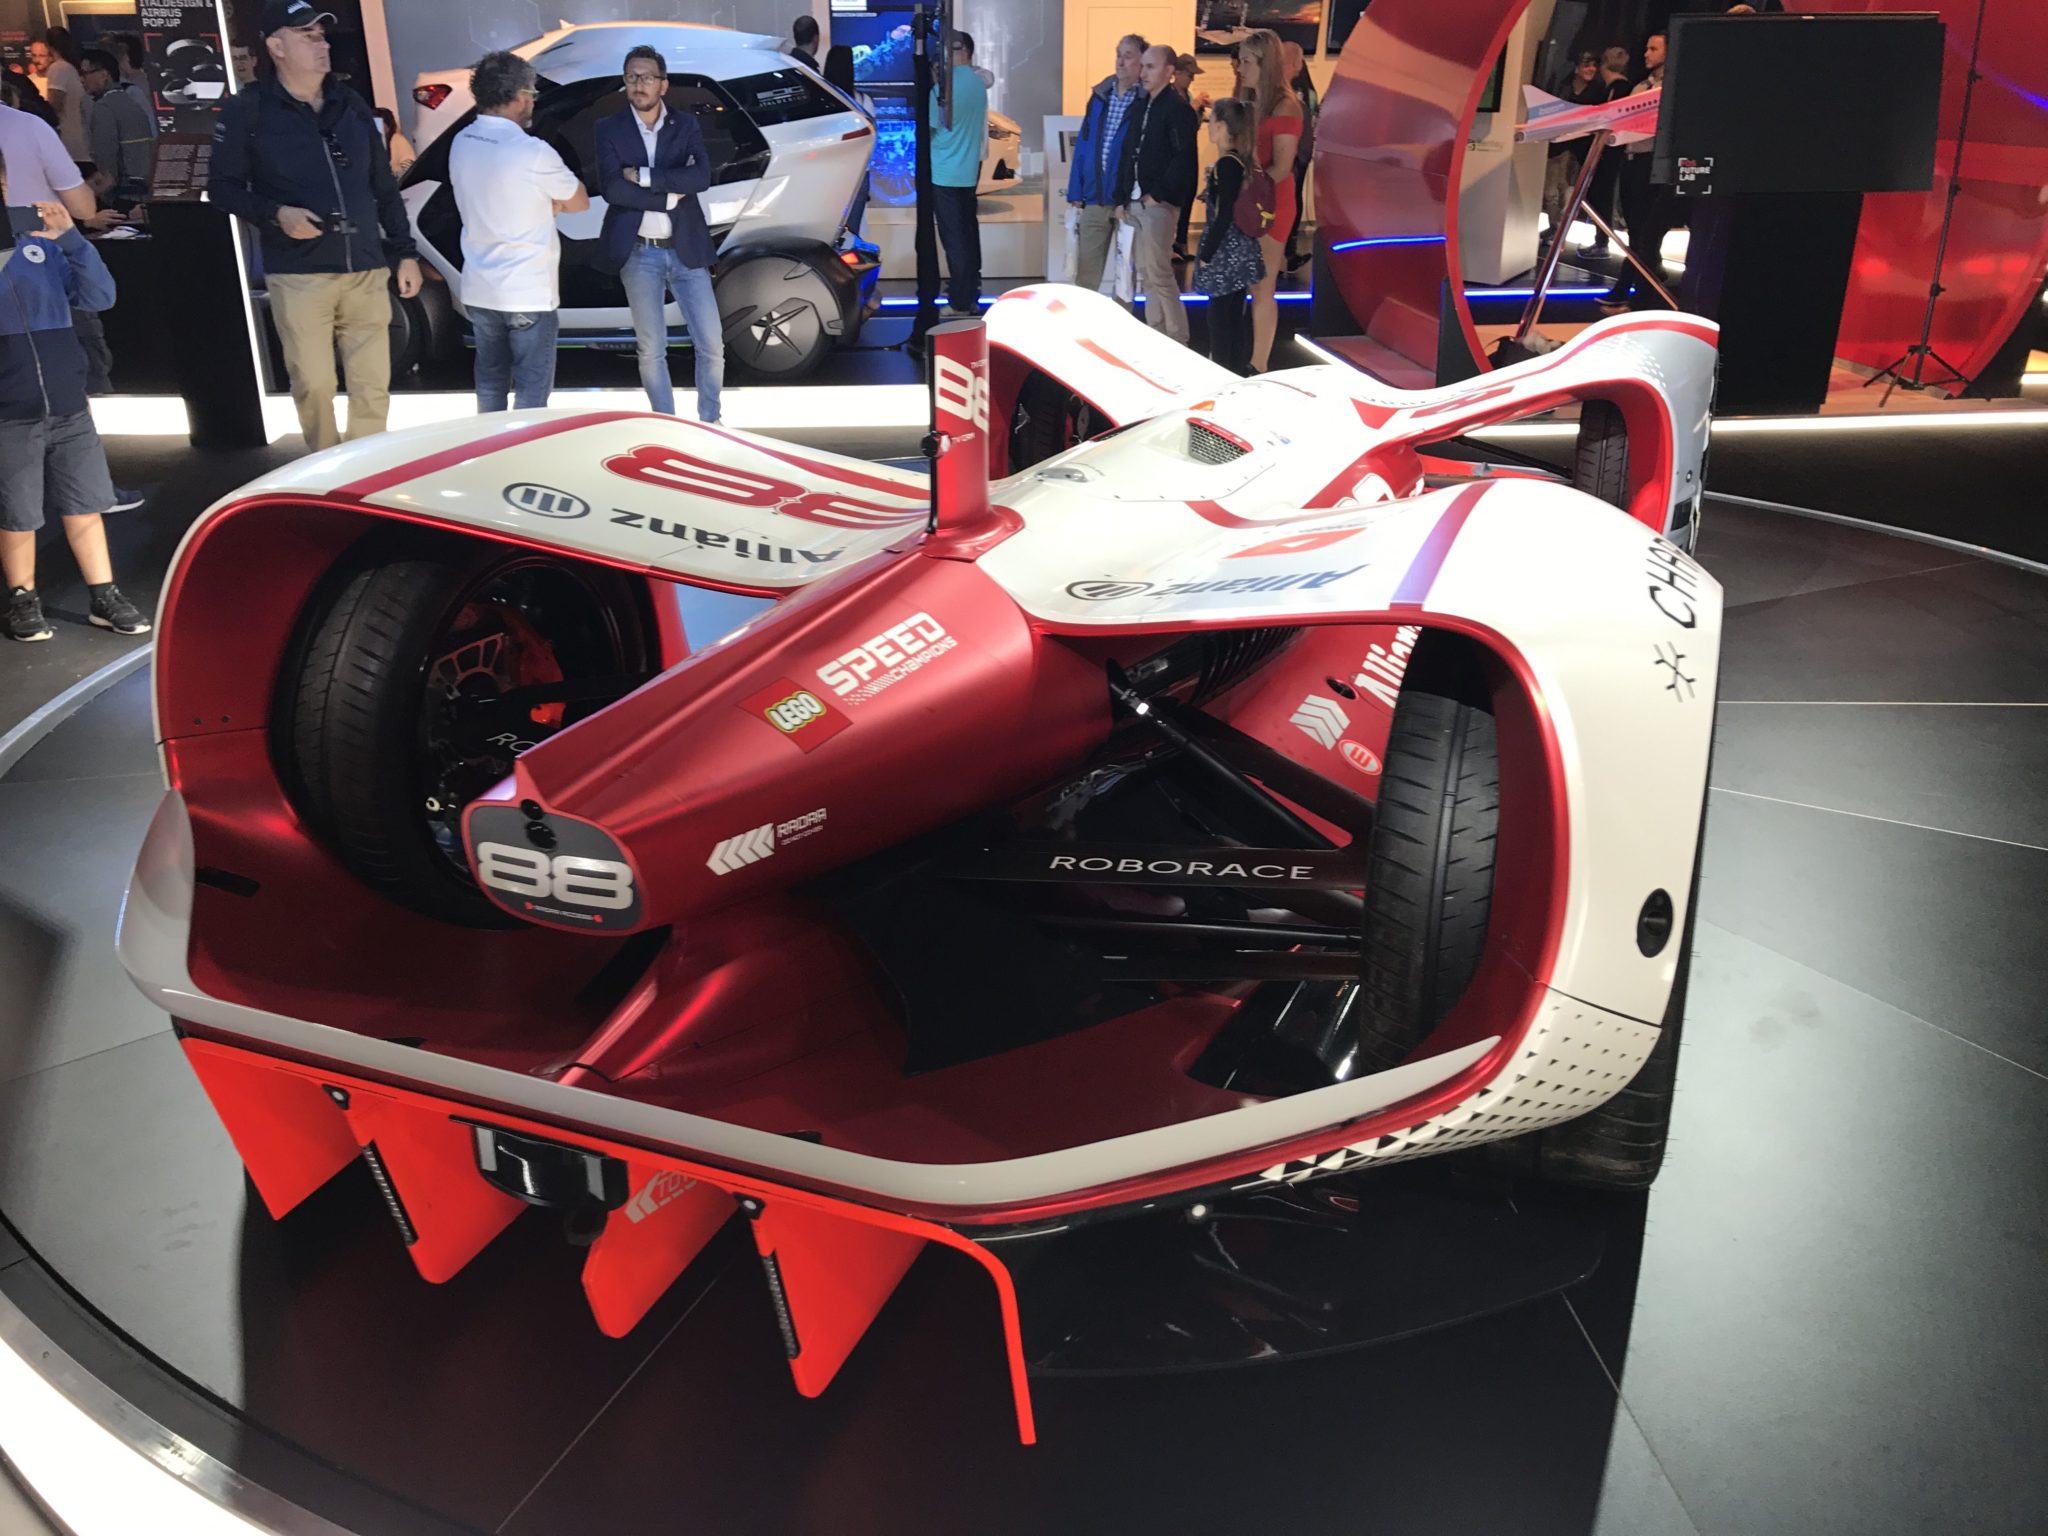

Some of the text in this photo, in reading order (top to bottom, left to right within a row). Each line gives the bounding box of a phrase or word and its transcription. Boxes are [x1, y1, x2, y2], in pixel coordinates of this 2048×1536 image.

[141, 8, 182, 18] AIRBUS
[142, 18, 181, 27] POP.UP
[1679, 166, 1711, 174] FUTURE
[1679, 173, 1696, 181] LAB
[609, 507, 845, 565] Allianz
[1148, 563, 1371, 598] Allianz
[816, 611, 946, 697] SPEED
[764, 689, 826, 732] LEGO
[476, 841, 634, 911] 88
[1049, 855, 1313, 881] ROBORACE
